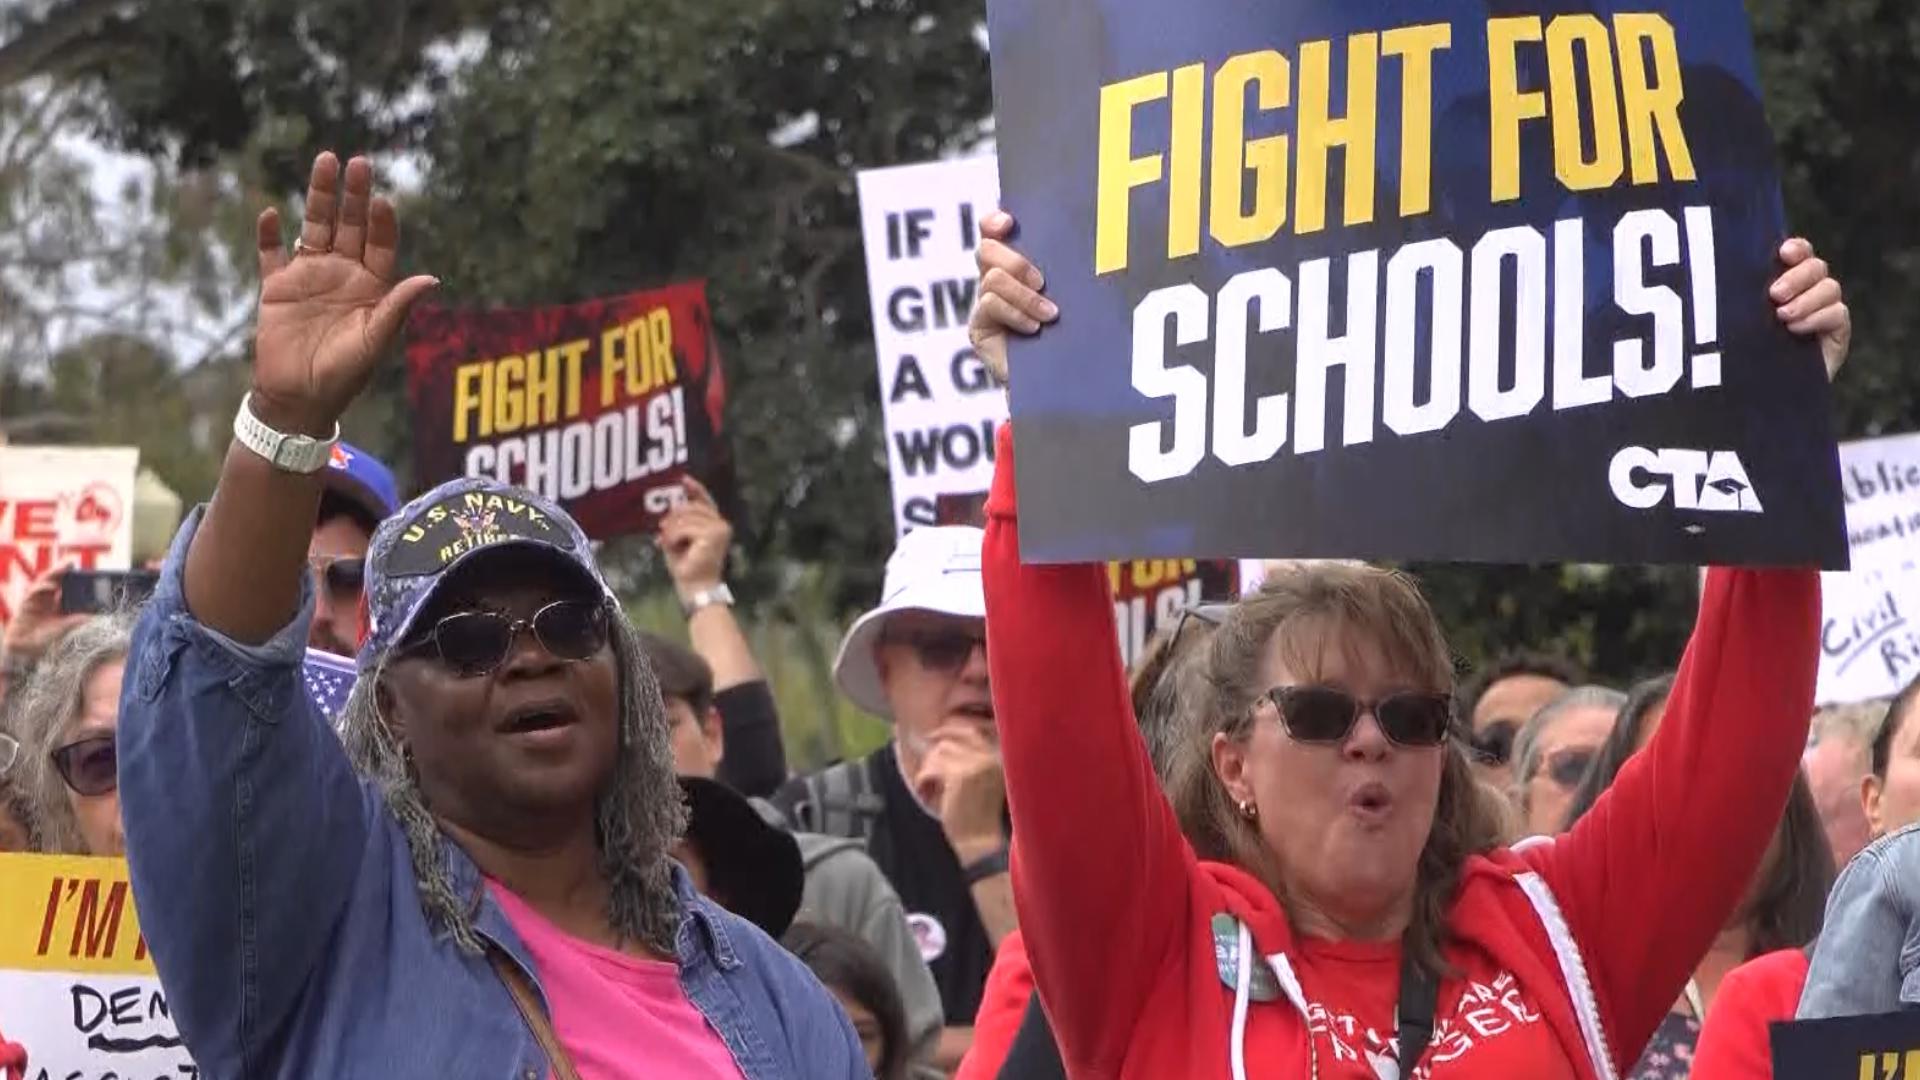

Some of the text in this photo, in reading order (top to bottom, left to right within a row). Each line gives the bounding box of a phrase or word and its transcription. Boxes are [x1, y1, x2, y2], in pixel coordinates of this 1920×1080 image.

[1095, 12, 1696, 276] FIGHT FOR
[886, 203, 976, 260] IF I
[452, 307, 676, 442] FIGHT FOR
[891, 346, 1000, 404] A G
[1127, 206, 1722, 484] SCHOOLS!
[644, 486, 688, 513] CT
[1609, 446, 1764, 514] CTA
[1843, 462, 1920, 503] blic
[37, 877, 128, 959] I'M
